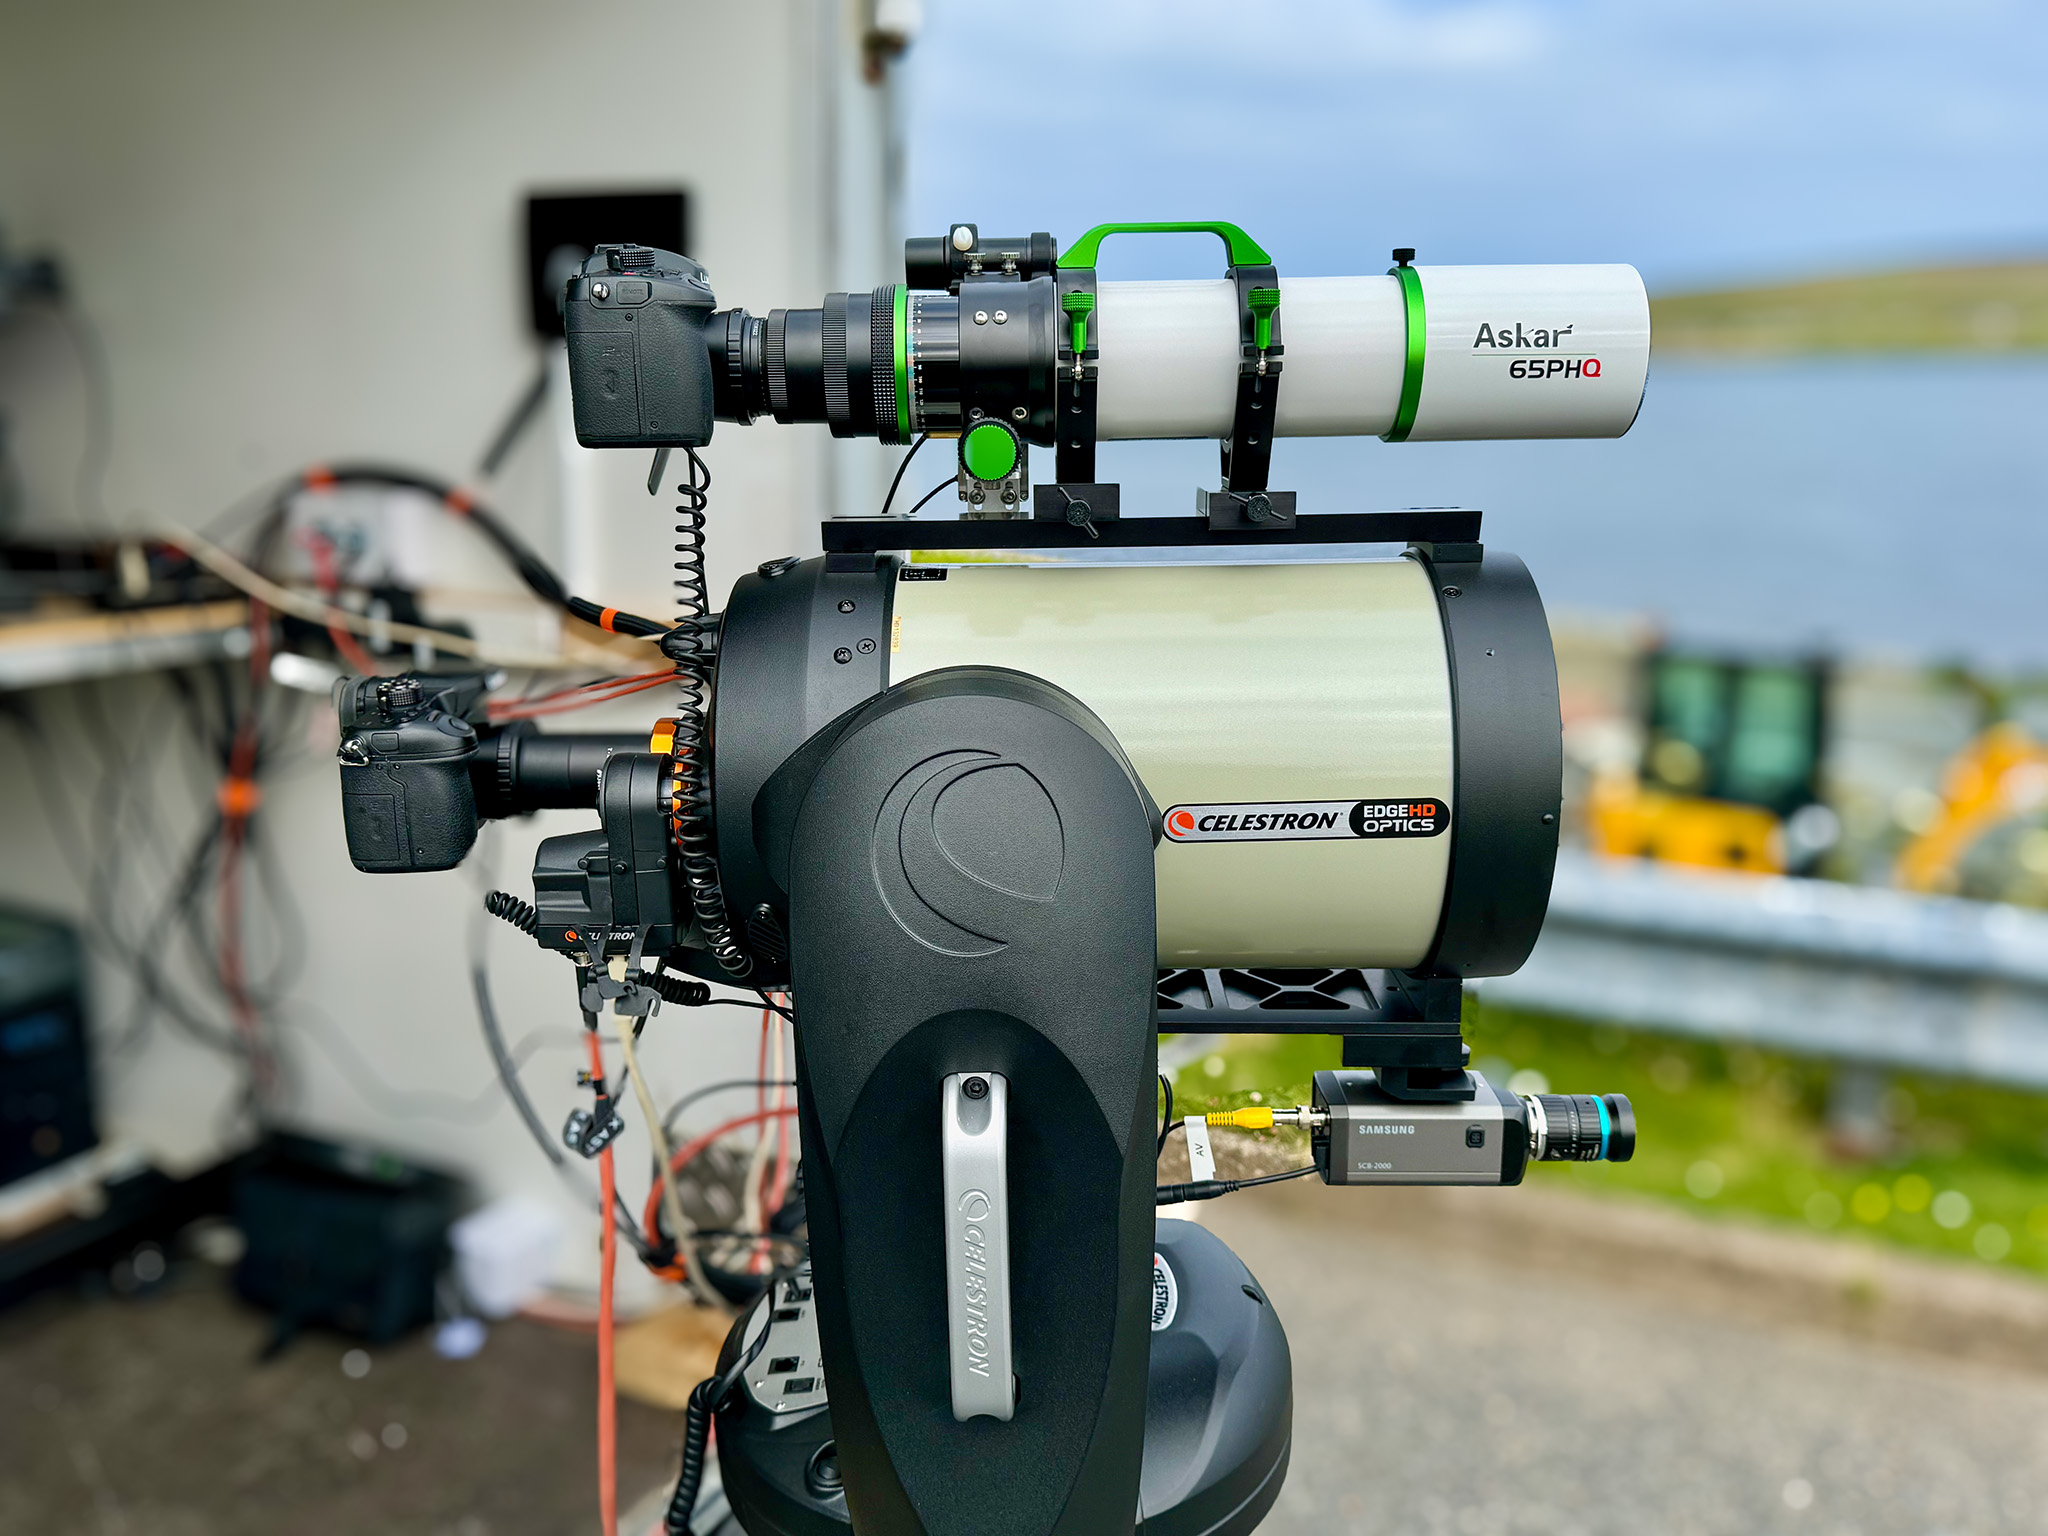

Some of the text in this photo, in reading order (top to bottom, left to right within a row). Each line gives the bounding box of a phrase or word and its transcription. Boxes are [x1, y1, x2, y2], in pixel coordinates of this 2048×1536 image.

[1473, 323, 1573, 348] Askar
[1508, 358, 1601, 379] 65PHQ
[1198, 803, 1436, 833] CELESTRON EDGEHD
[1363, 818, 1435, 833] OPTICS
[1358, 1125, 1416, 1135] SAMSUNG
[1195, 1143, 1205, 1157] AV
[1357, 1162, 1393, 1170] SCB-2000
[964, 1223, 990, 1378] CELESTRON
